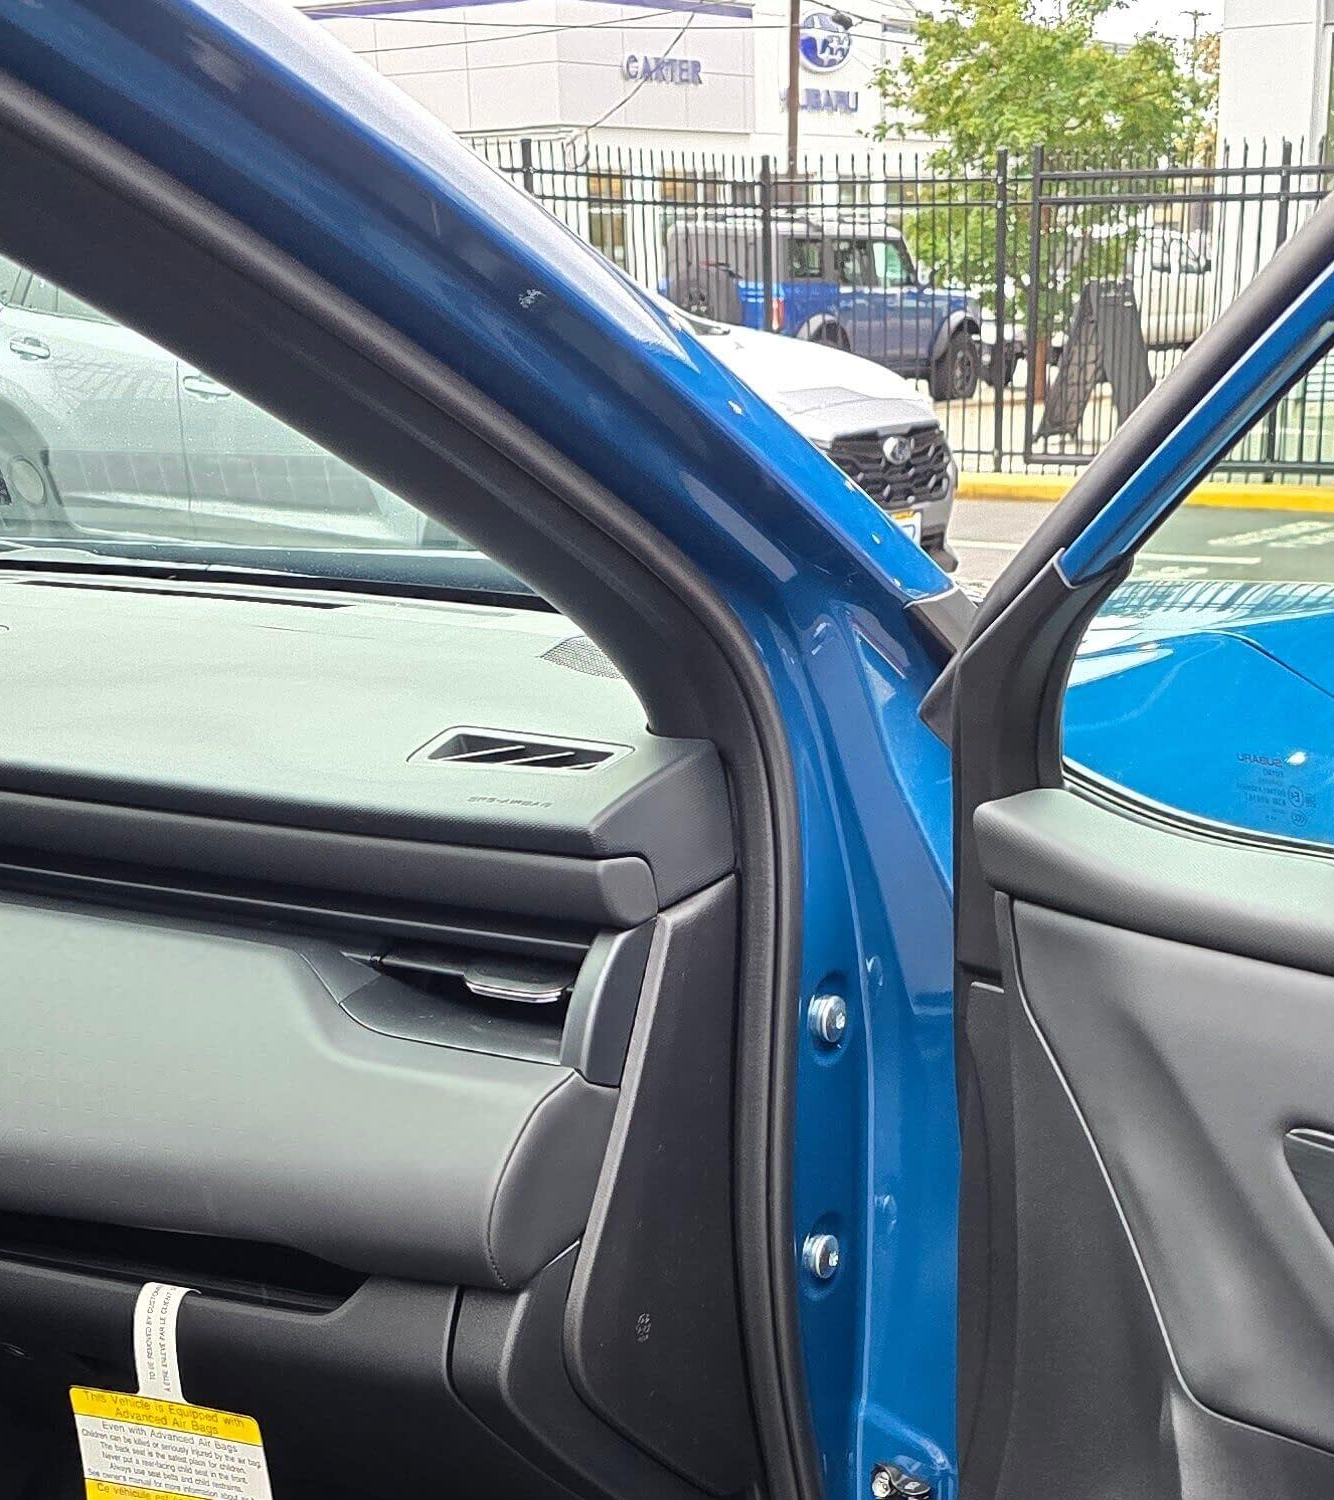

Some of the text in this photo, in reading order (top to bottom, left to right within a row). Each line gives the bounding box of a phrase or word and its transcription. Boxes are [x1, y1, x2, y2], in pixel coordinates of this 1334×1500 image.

[625, 55, 702, 84] CARTER
[83, 1390, 244, 1427] This Vehicle is Equipped with
[114, 1407, 219, 1436] Advanced Air Bags
[101, 1421, 238, 1454] Even with Advanced Air Bags
